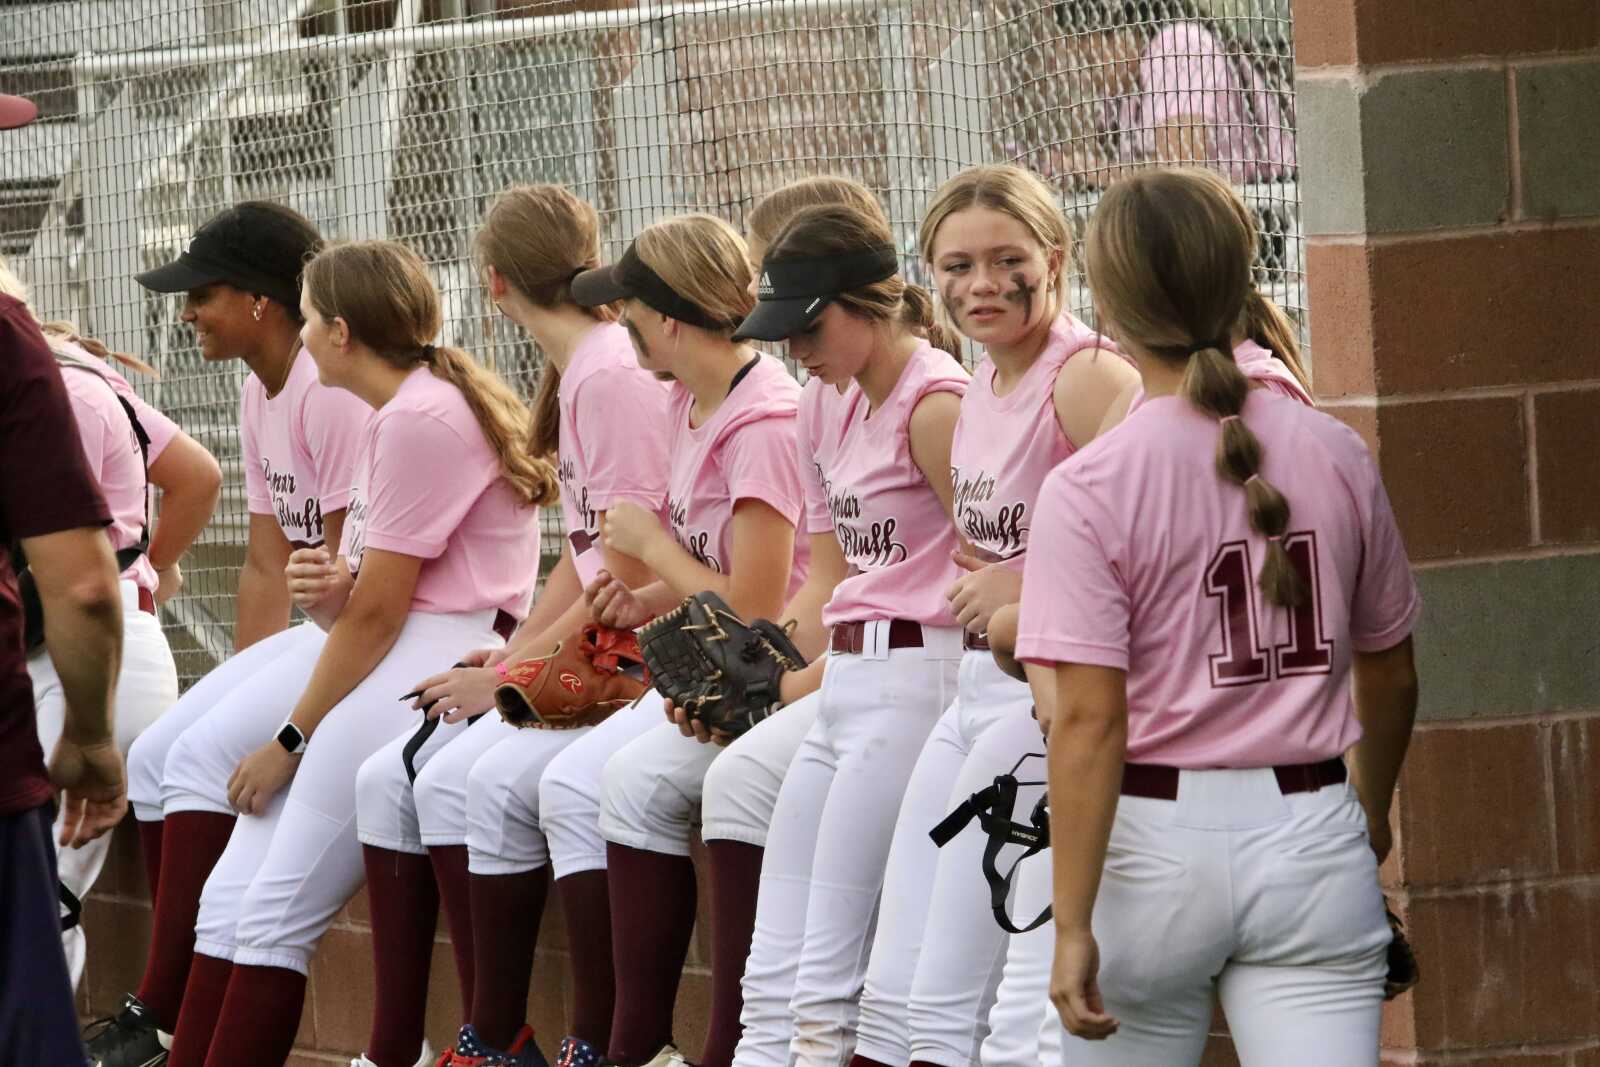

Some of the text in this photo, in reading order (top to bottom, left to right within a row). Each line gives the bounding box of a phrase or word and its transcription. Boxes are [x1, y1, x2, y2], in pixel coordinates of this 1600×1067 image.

[838, 518, 907, 566] Bluff
[963, 503, 1030, 552] Bluff
[1204, 530, 1334, 688] 11
